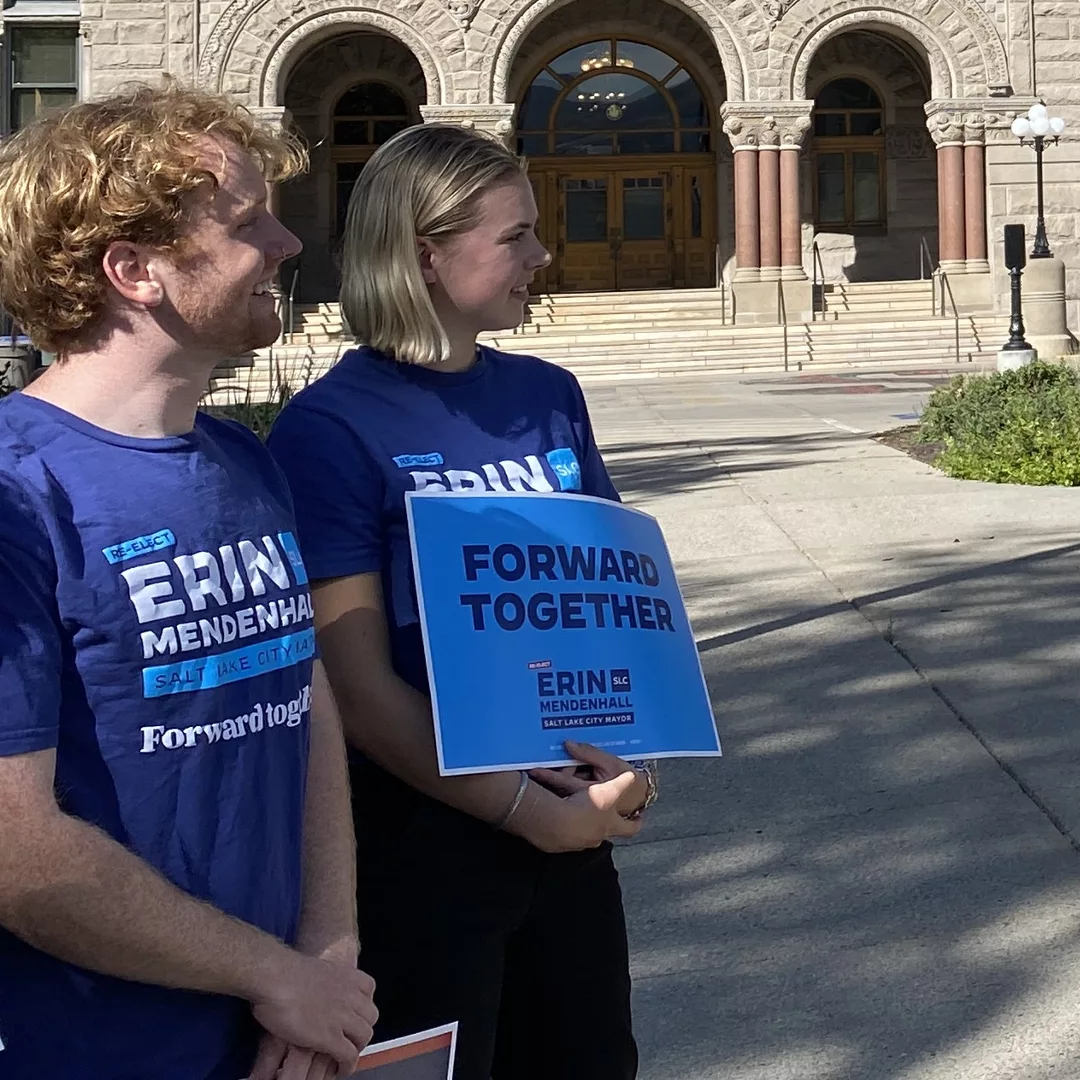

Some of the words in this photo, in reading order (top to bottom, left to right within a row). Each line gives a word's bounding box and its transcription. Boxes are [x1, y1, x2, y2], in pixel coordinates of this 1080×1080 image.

[110, 532, 172, 560] RE-ELECT
[462, 543, 660, 587] FORWARD
[121, 535, 290, 623] ERIN
[141, 593, 314, 659] MENDENHAL
[460, 592, 676, 633] TOGETHER
[155, 666, 206, 689] SALT
[217, 656, 251, 678] LAKE
[257, 645, 293, 666] CITY
[537, 669, 607, 697] ERIN
[612, 676, 629, 685] SLC
[540, 696, 633, 713] MENDENHALL
[544, 719, 562, 728] SALT
[564, 717, 584, 726] LAKE
[585, 716, 604, 725] CITY
[605, 714, 632, 723] MAYOR
[140, 703, 264, 752] Forward
